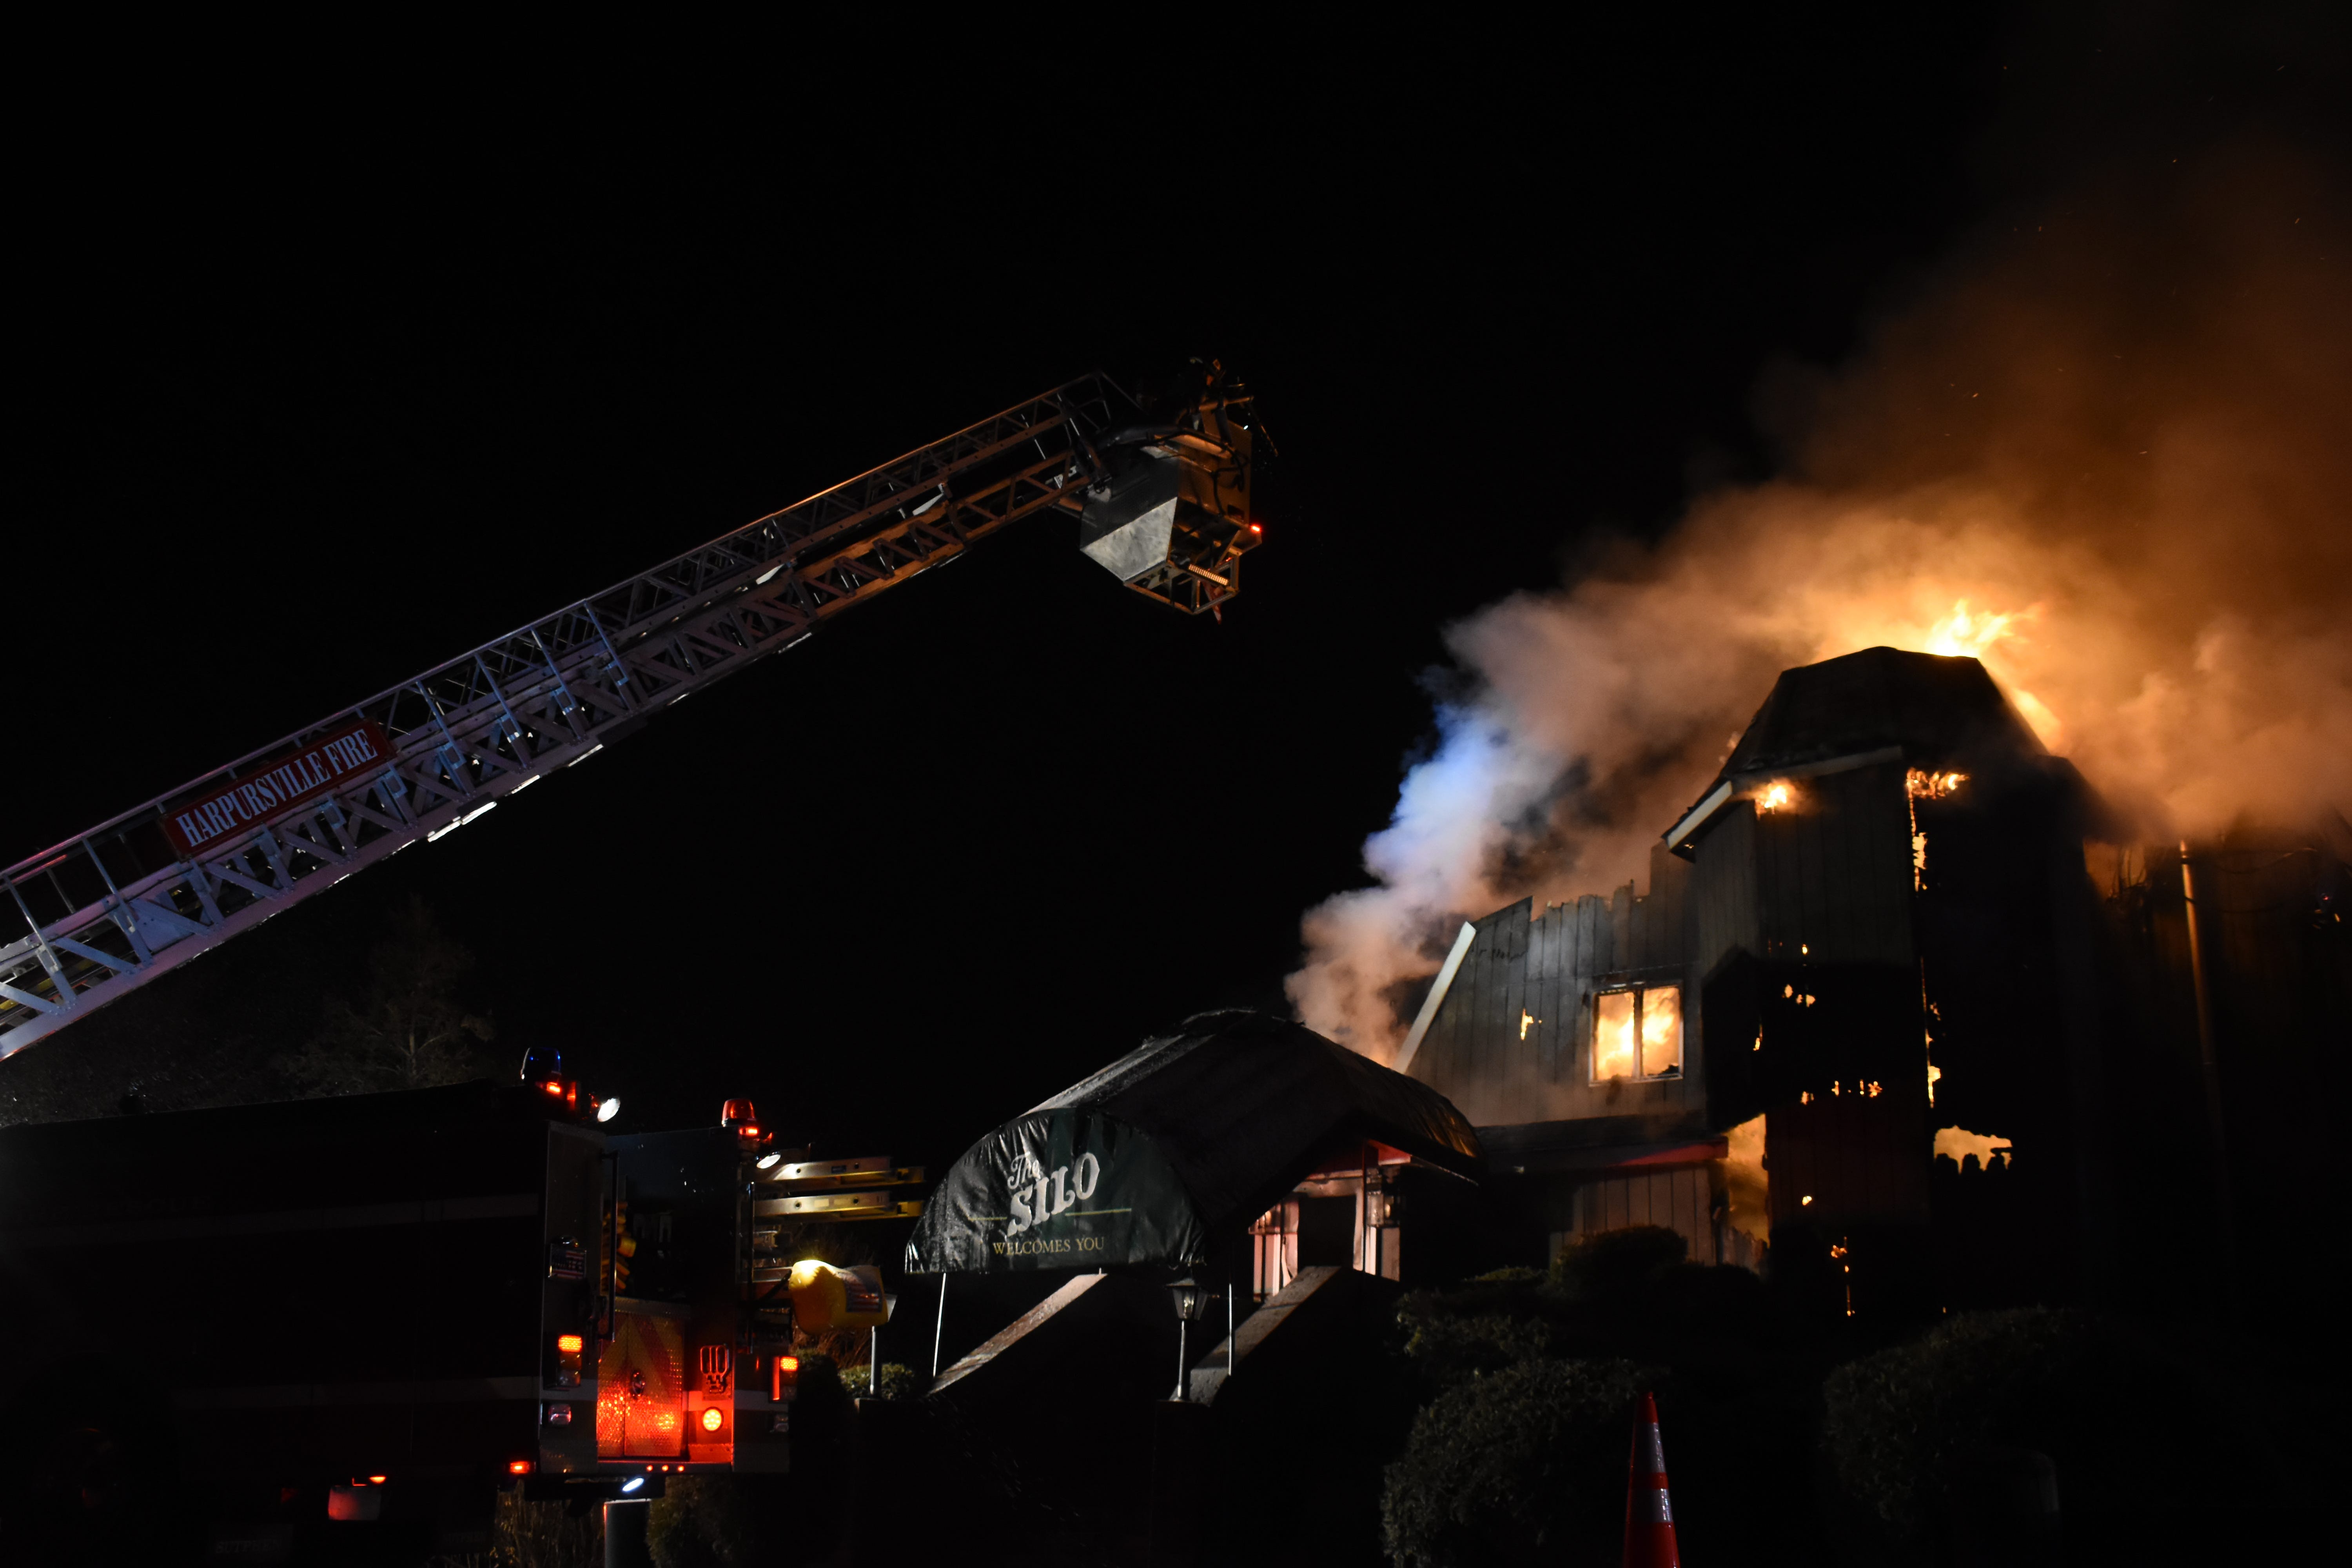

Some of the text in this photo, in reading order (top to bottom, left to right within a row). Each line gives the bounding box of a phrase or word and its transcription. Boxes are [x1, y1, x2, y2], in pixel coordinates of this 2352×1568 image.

[176, 729, 378, 847] HARPURSVILLE FIRE
[1007, 1151, 1041, 1189] The
[1007, 1152, 1100, 1237] SILO
[993, 1236, 1104, 1255] WELCOMES YOU
